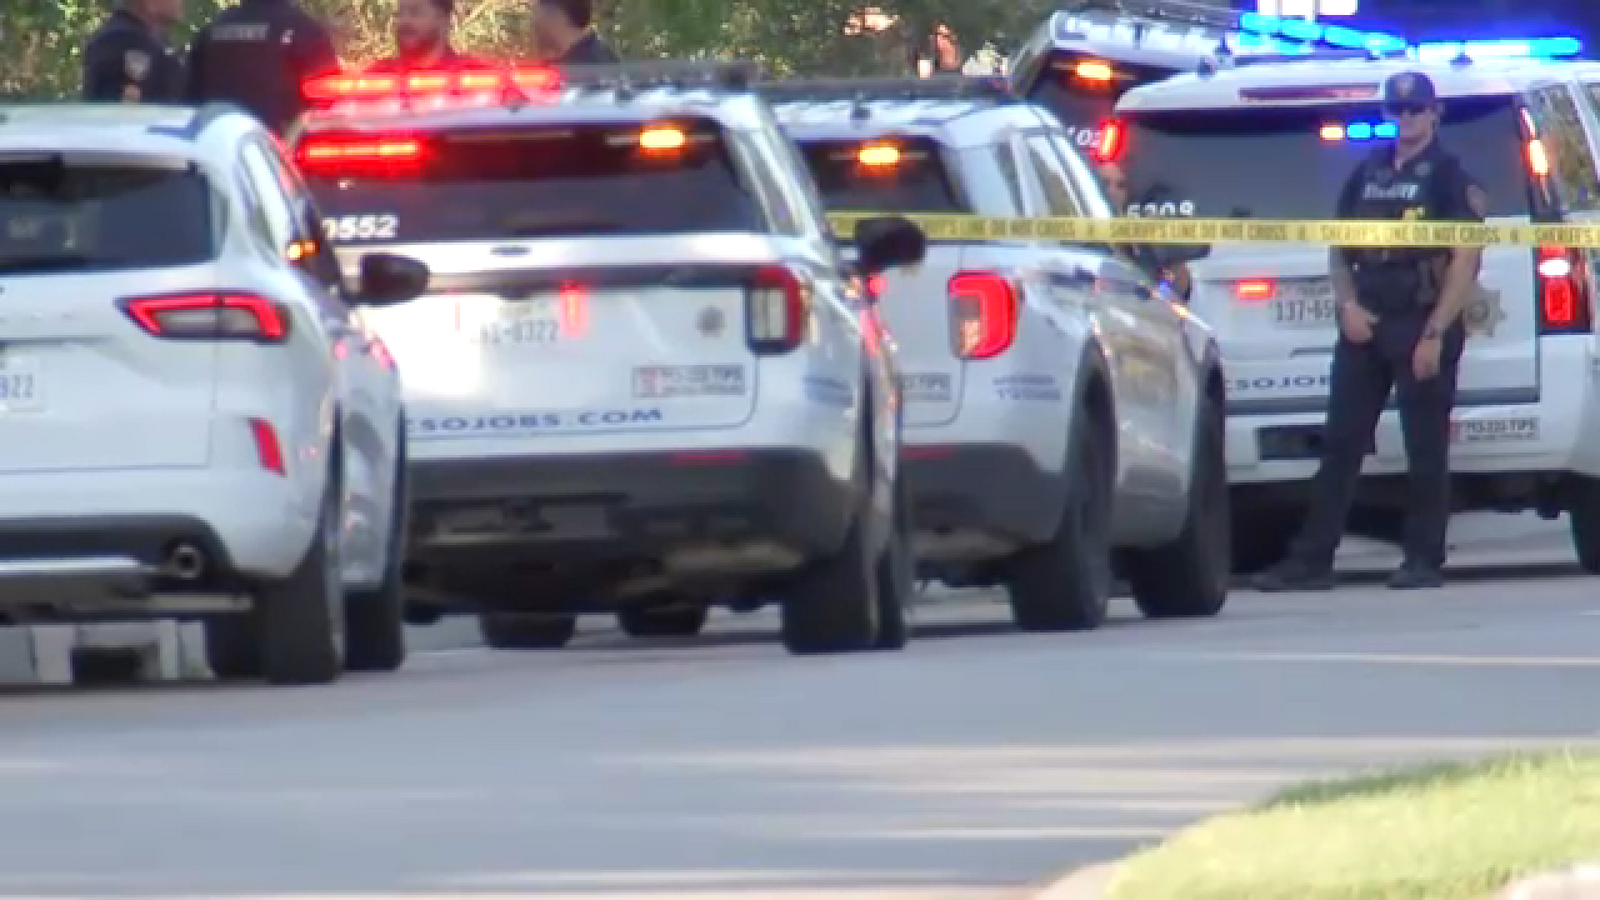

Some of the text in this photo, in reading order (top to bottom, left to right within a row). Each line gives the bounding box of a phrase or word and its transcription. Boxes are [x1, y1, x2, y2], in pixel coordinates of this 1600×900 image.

[1201, 224, 1219, 240] DO
[1221, 224, 1243, 241] NOT
[1247, 224, 1288, 241] CROSS
[1412, 226, 1430, 242] DO
[1433, 226, 1455, 242] NOT
[1459, 226, 1500, 243] CROSS
